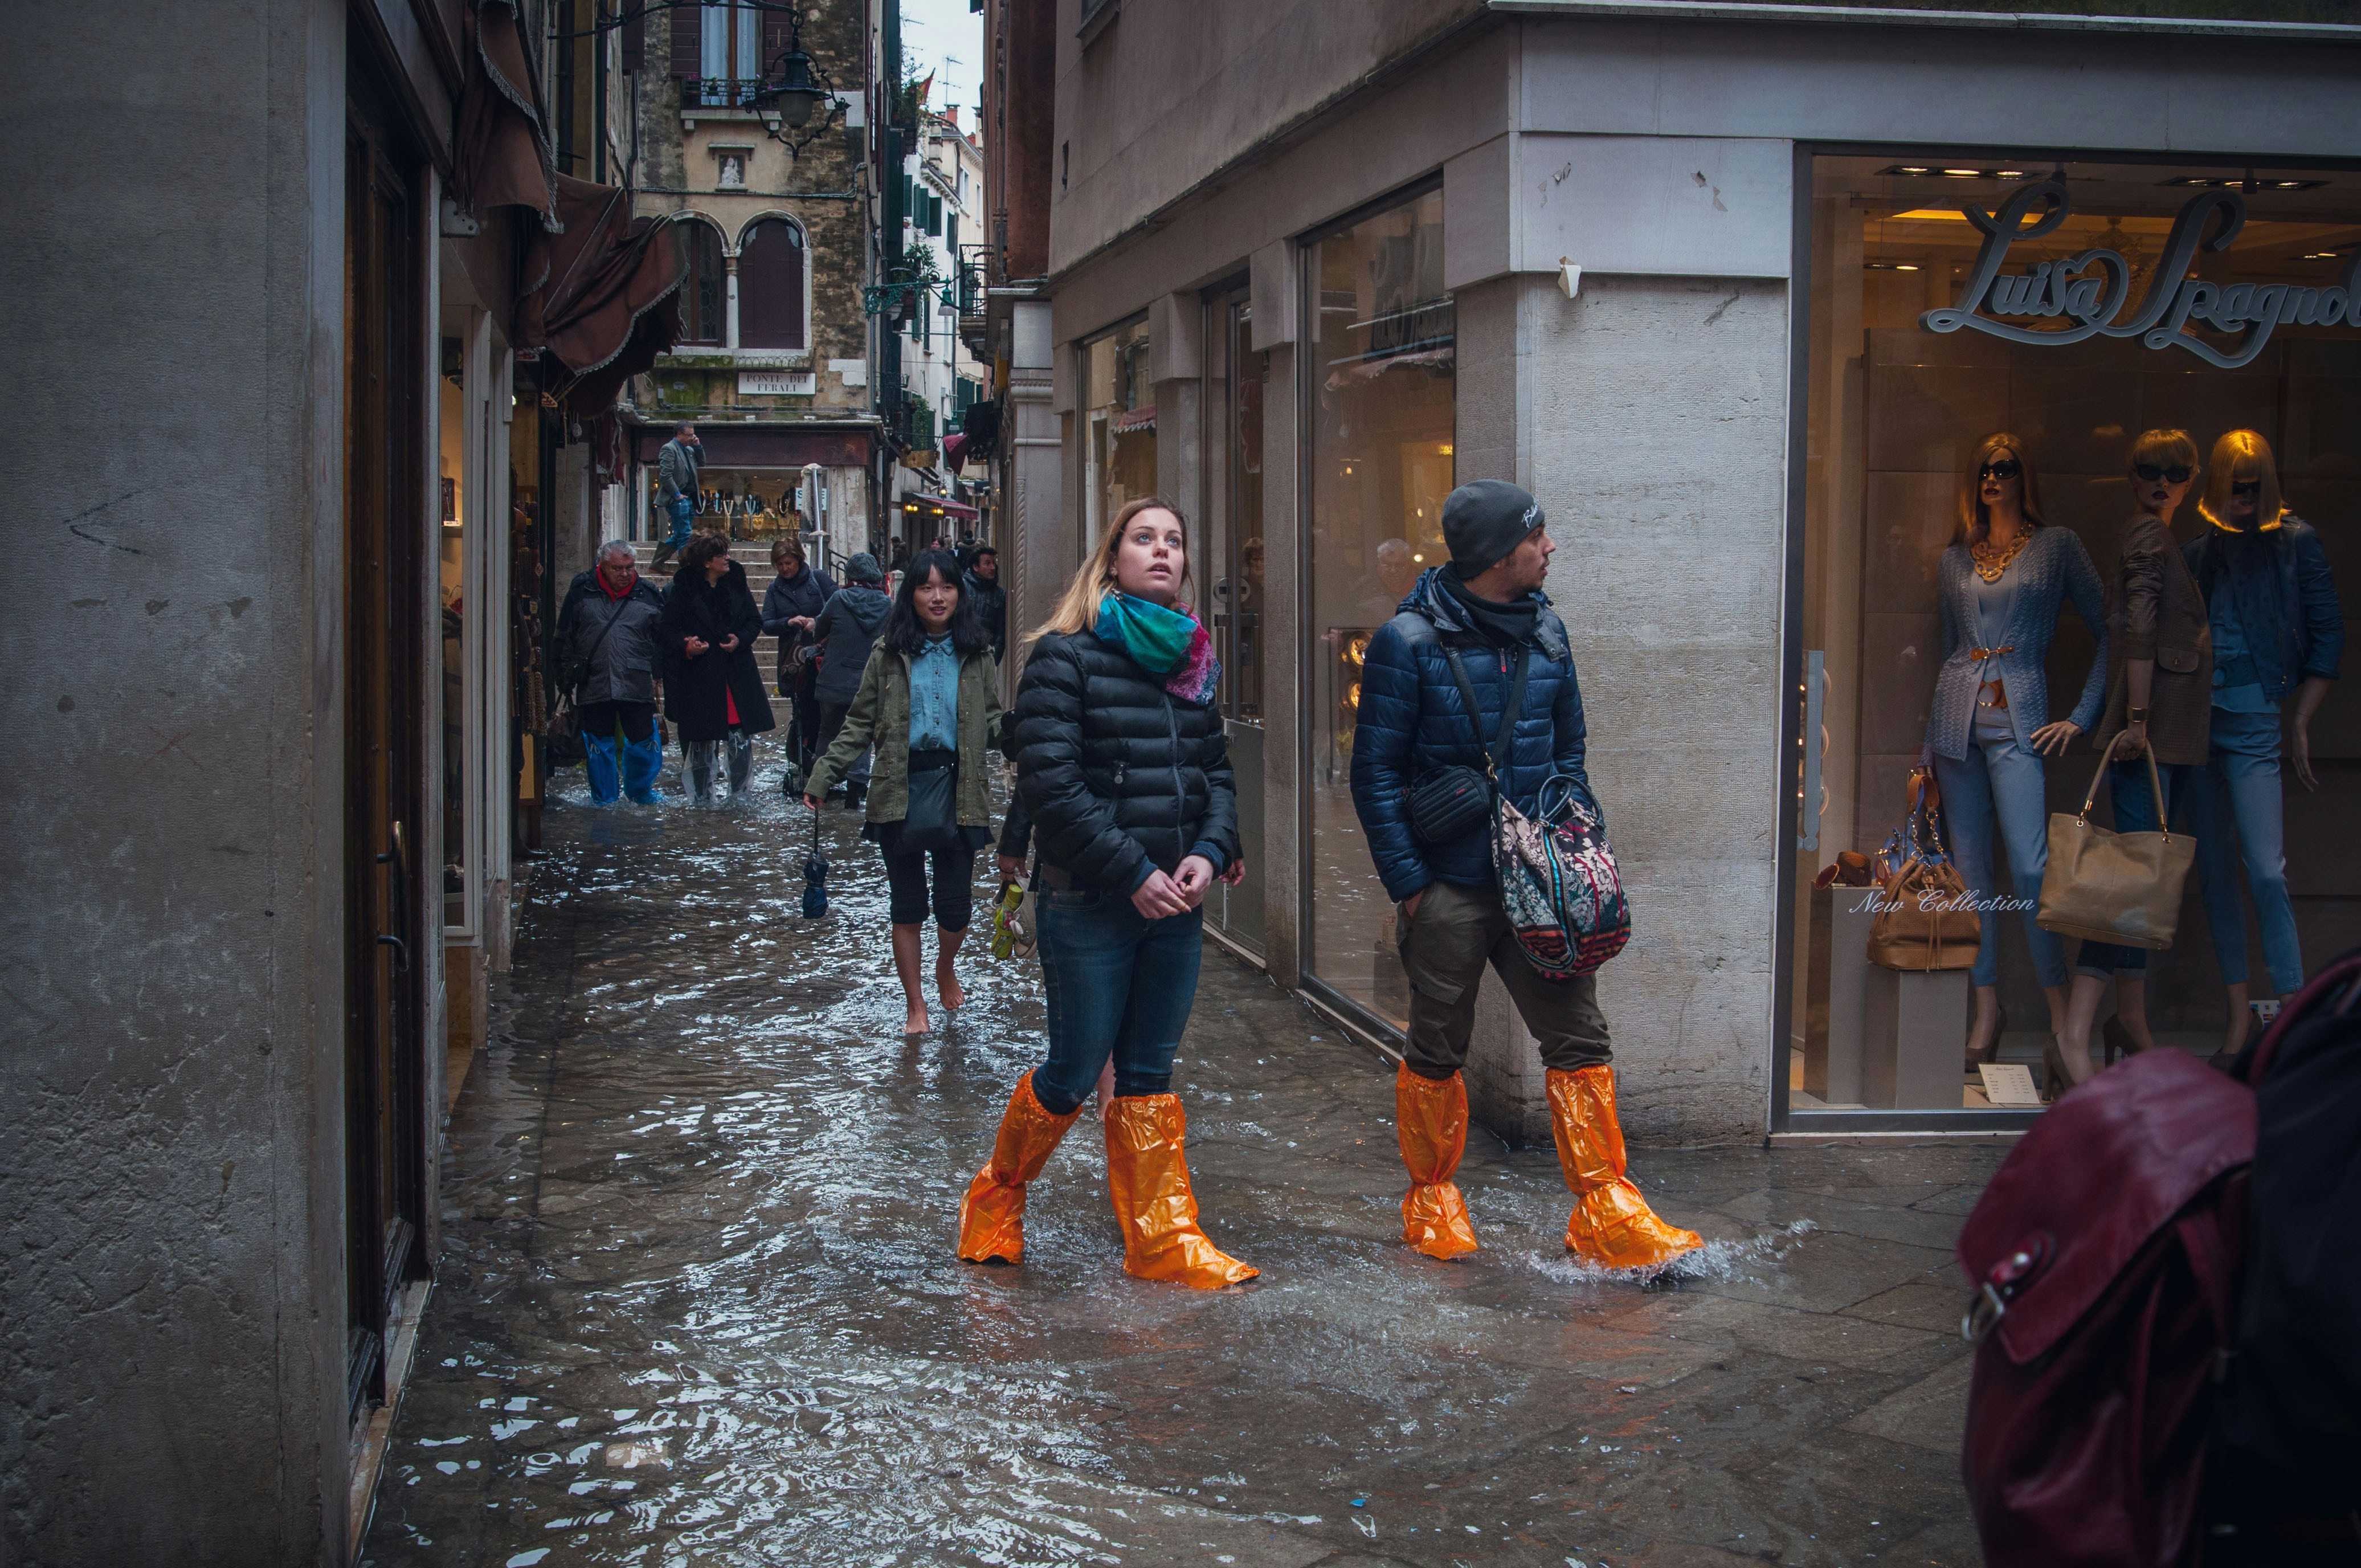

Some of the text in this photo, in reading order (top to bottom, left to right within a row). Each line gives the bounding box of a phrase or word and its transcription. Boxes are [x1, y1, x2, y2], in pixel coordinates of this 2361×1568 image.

[1926, 181, 2129, 346] Luisa
[747, 373, 807, 383] PONTE DEI
[758, 383, 796, 392] FERALI
[1849, 889, 2035, 913] New Collection
